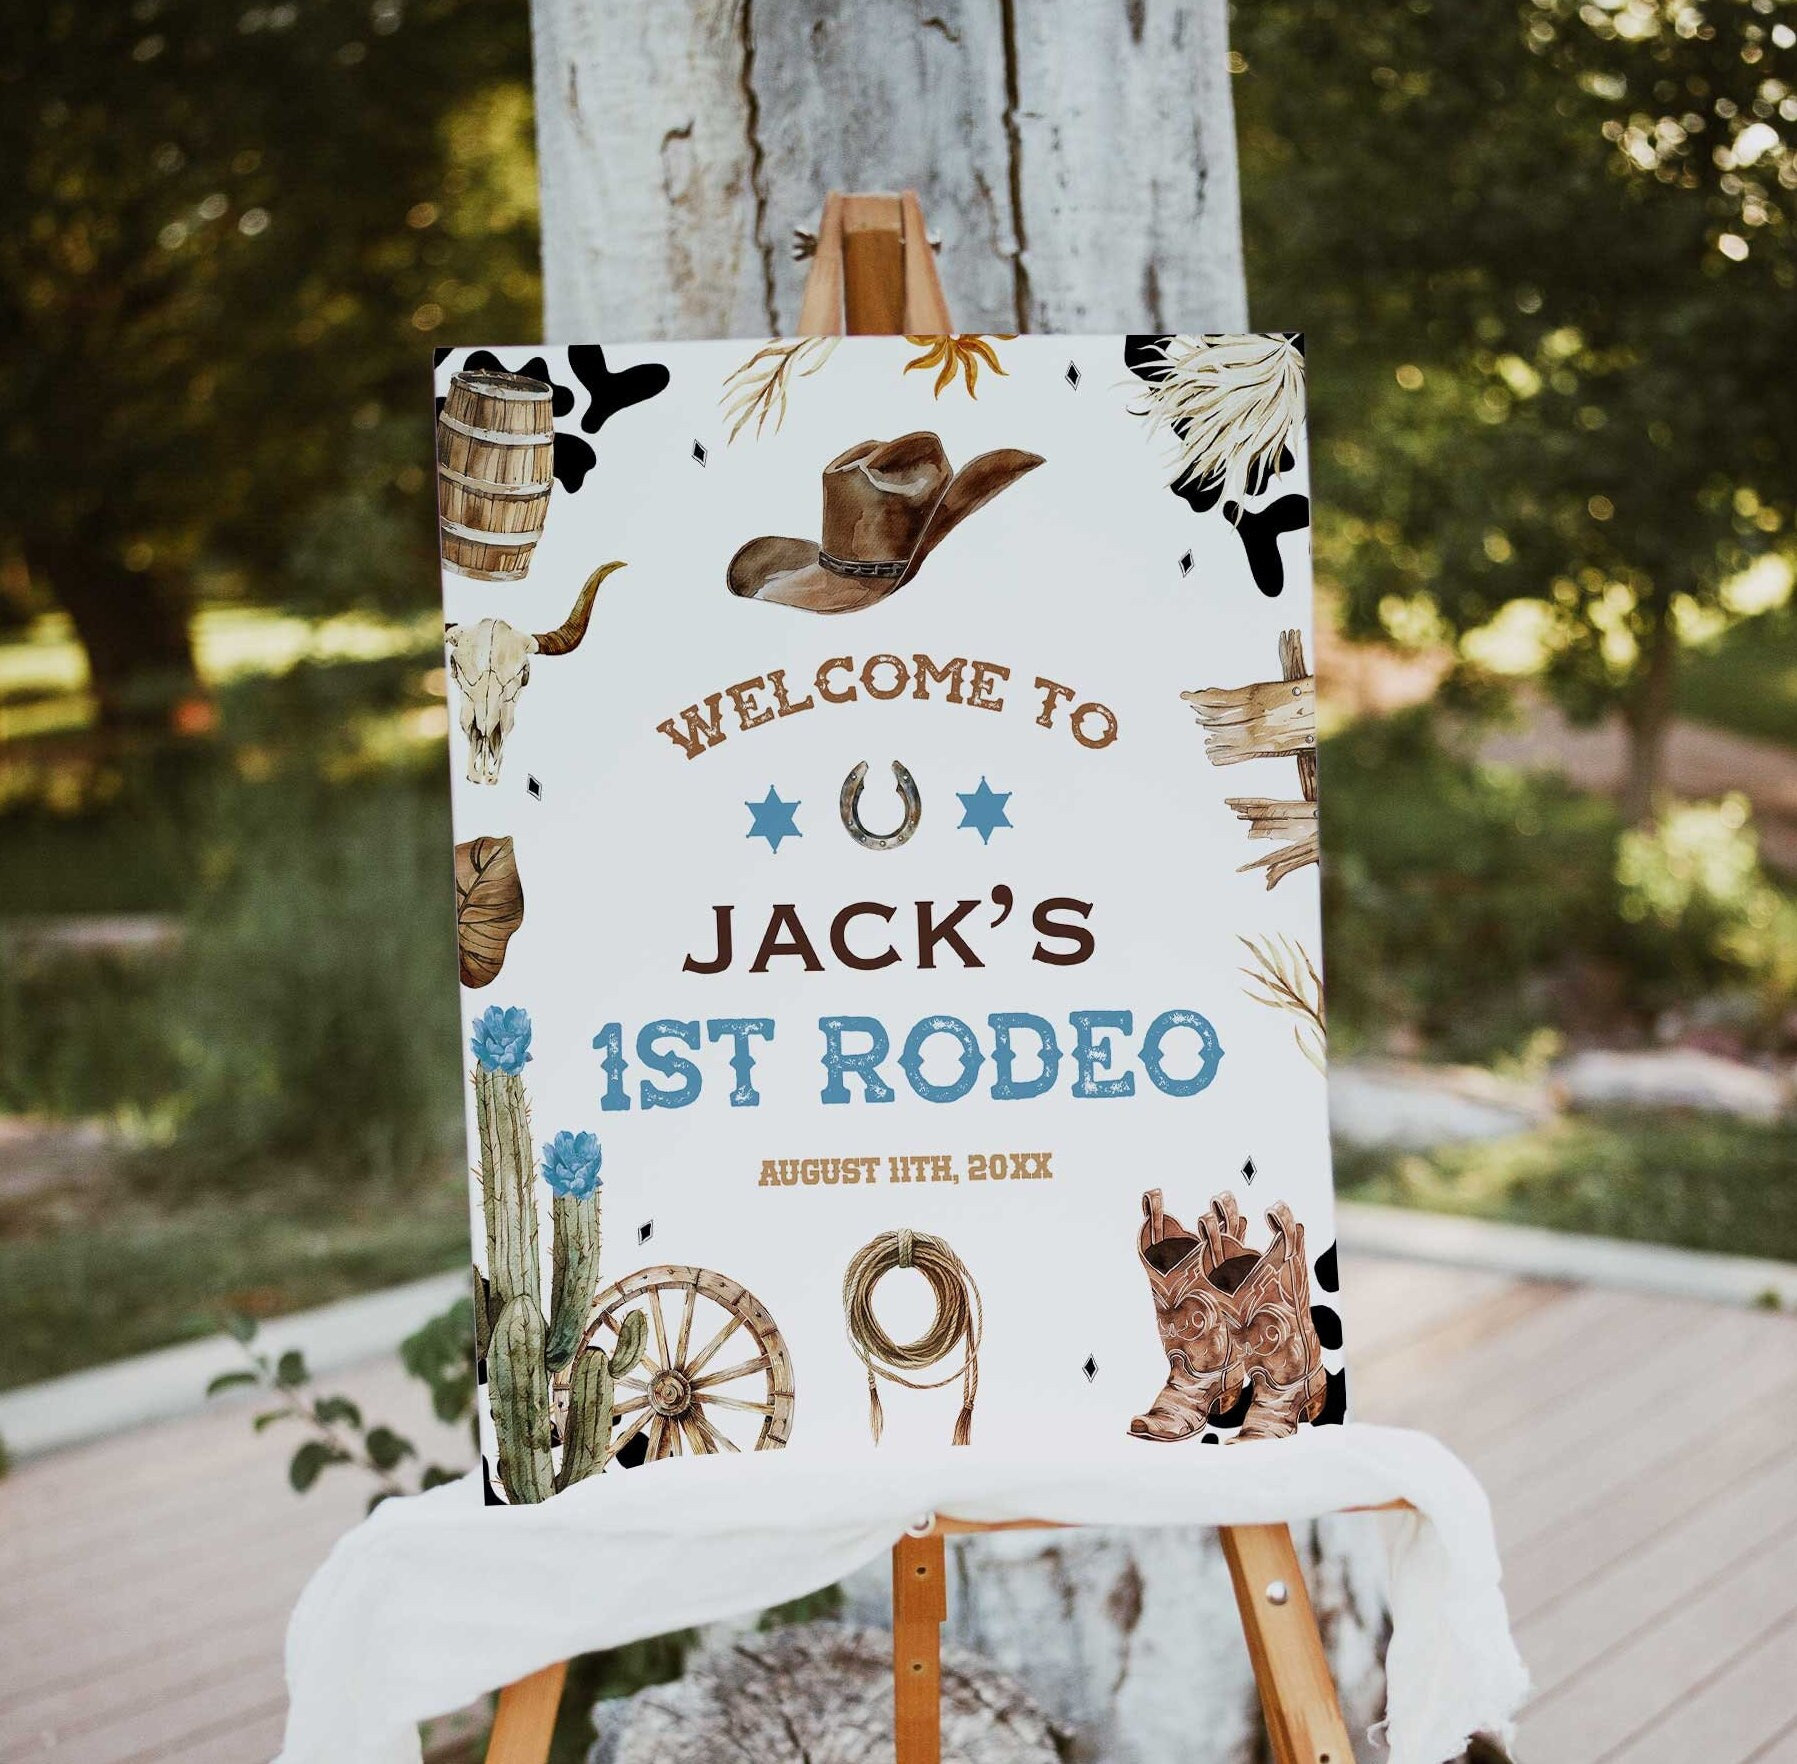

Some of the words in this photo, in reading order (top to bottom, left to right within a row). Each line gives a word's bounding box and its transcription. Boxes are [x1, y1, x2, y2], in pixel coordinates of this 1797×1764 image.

[656, 654, 1010, 760] WELCOME
[1034, 677, 1118, 749] TO
[682, 884, 1095, 974] JACK'S
[592, 1018, 775, 1111] 1ST
[819, 1009, 1225, 1104] RODEO
[758, 1157, 880, 1186] AUGUST
[888, 1155, 959, 1184] 11TH,
[968, 1152, 1053, 1181] 20XX
